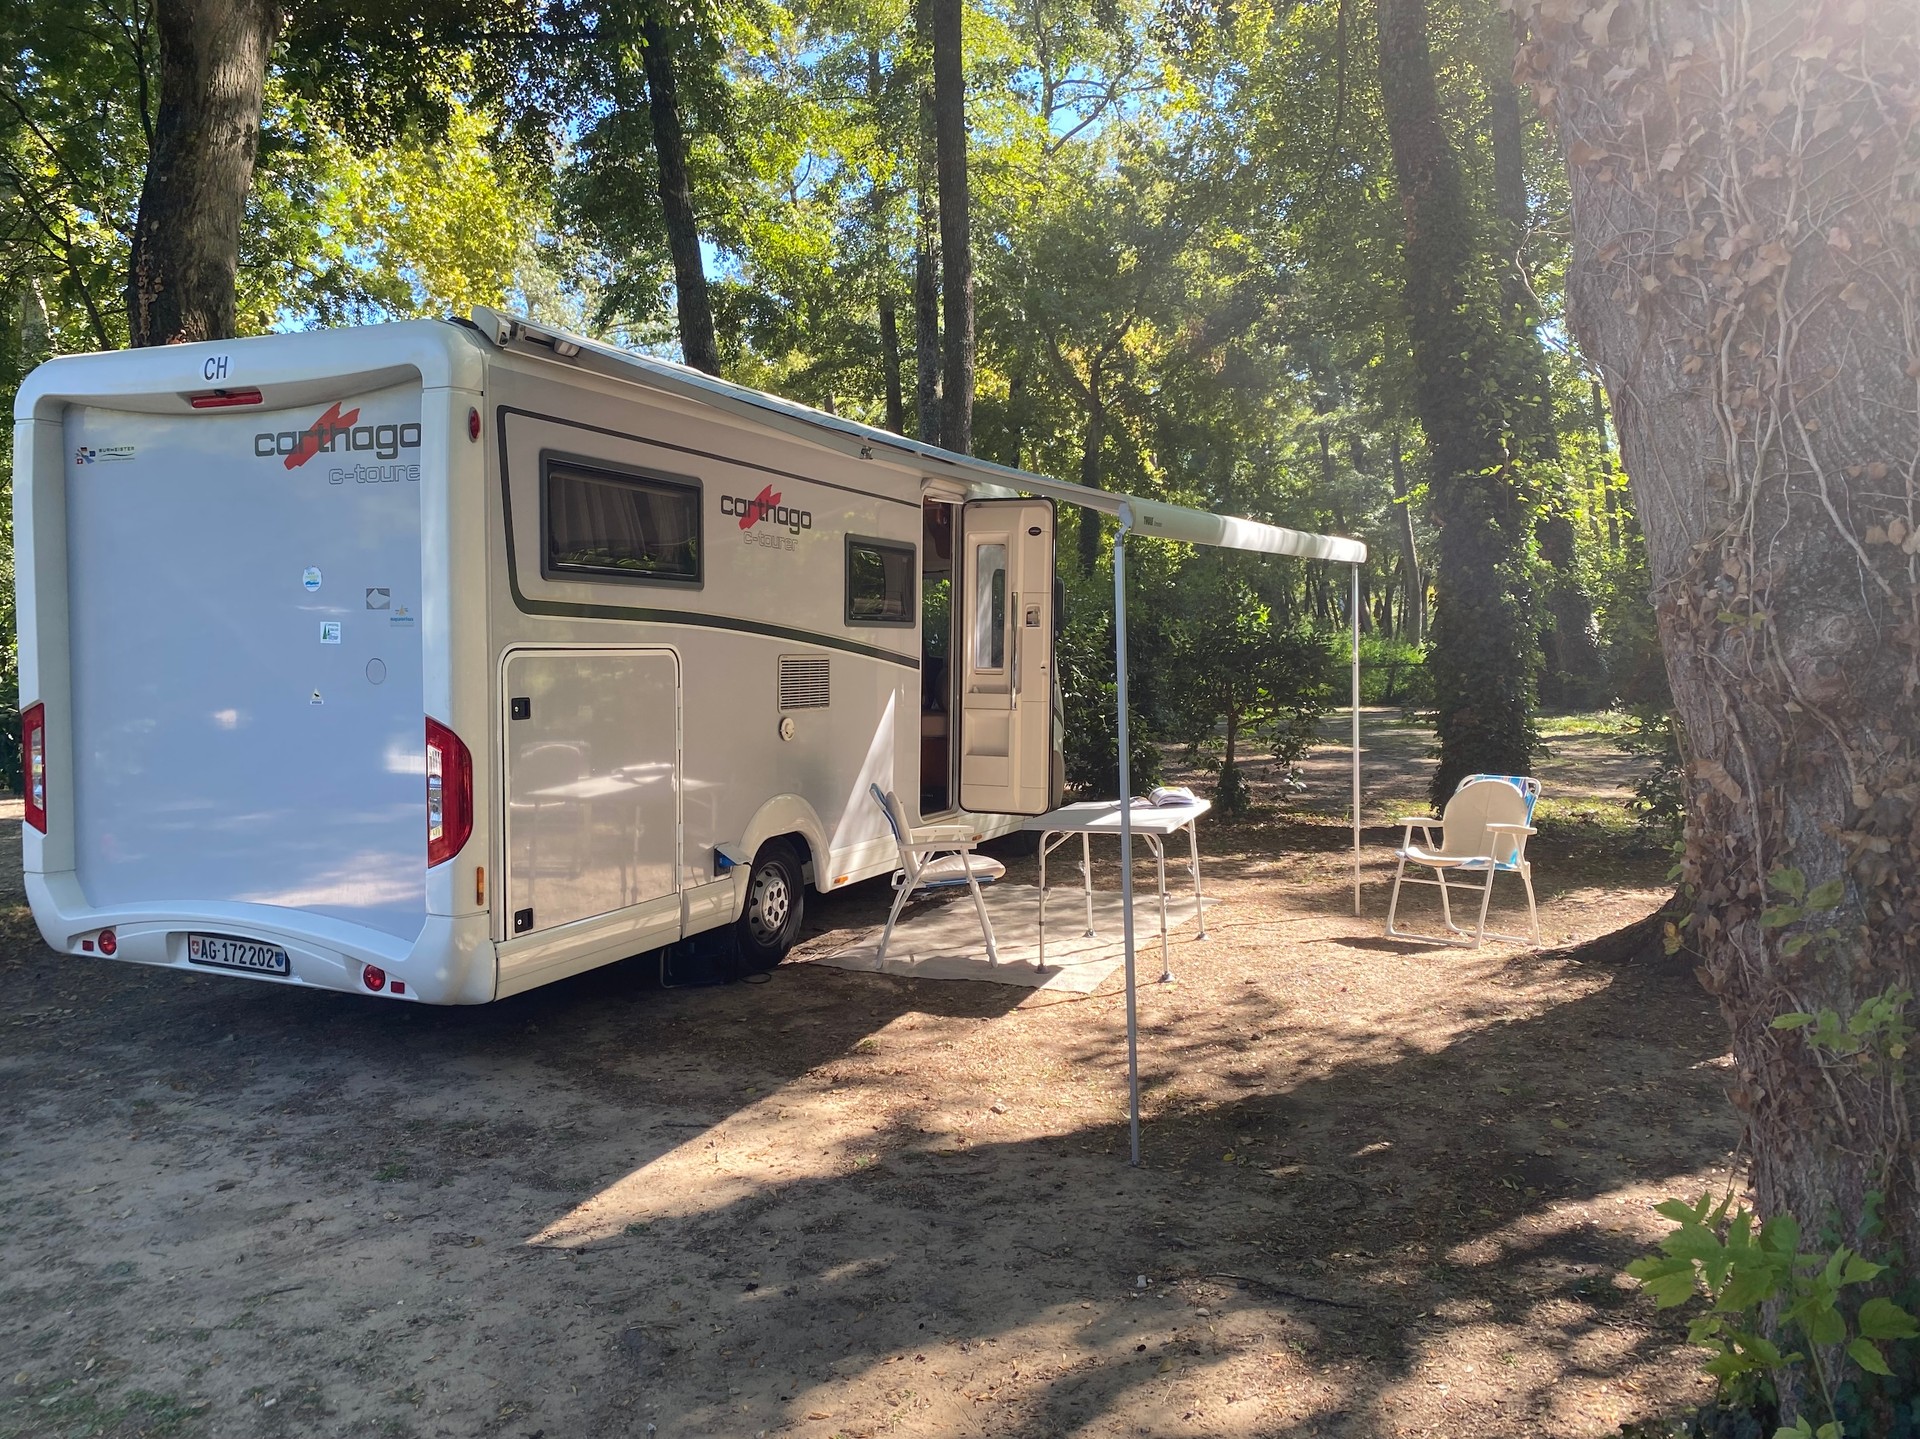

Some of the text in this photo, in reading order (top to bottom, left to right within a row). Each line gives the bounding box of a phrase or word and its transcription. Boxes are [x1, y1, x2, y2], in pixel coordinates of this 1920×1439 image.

[204, 355, 228, 380] CH
[254, 422, 421, 460] carthago
[720, 494, 812, 536] carthago
[743, 530, 798, 552] c-tourer
